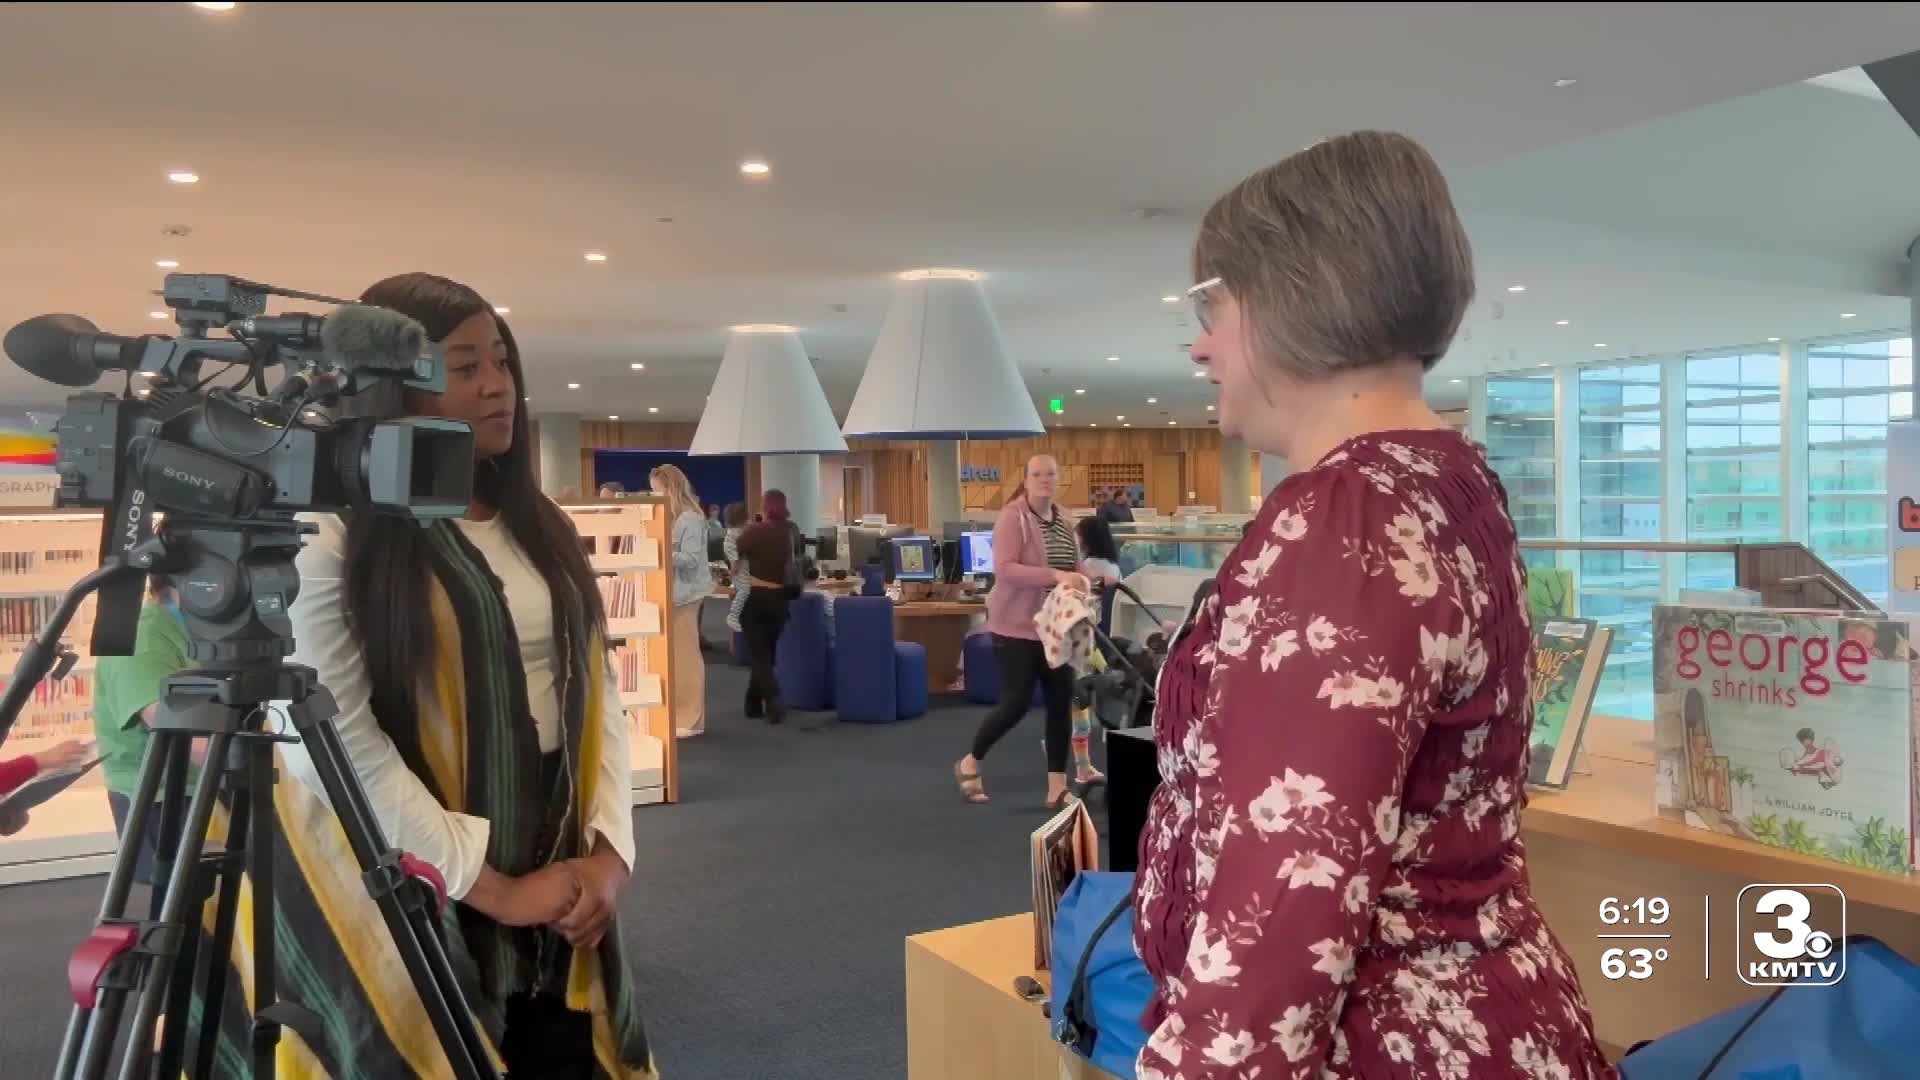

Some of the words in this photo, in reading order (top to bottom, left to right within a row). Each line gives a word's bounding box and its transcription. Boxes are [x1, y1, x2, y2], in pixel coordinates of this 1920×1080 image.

[162, 466, 215, 489] SONY
[124, 490, 145, 552] SONY
[1676, 625, 1868, 695] george
[1712, 672, 1796, 708] shrinks
[1775, 799, 1816, 815] WILLIAM
[1819, 808, 1853, 821] JOYCE
